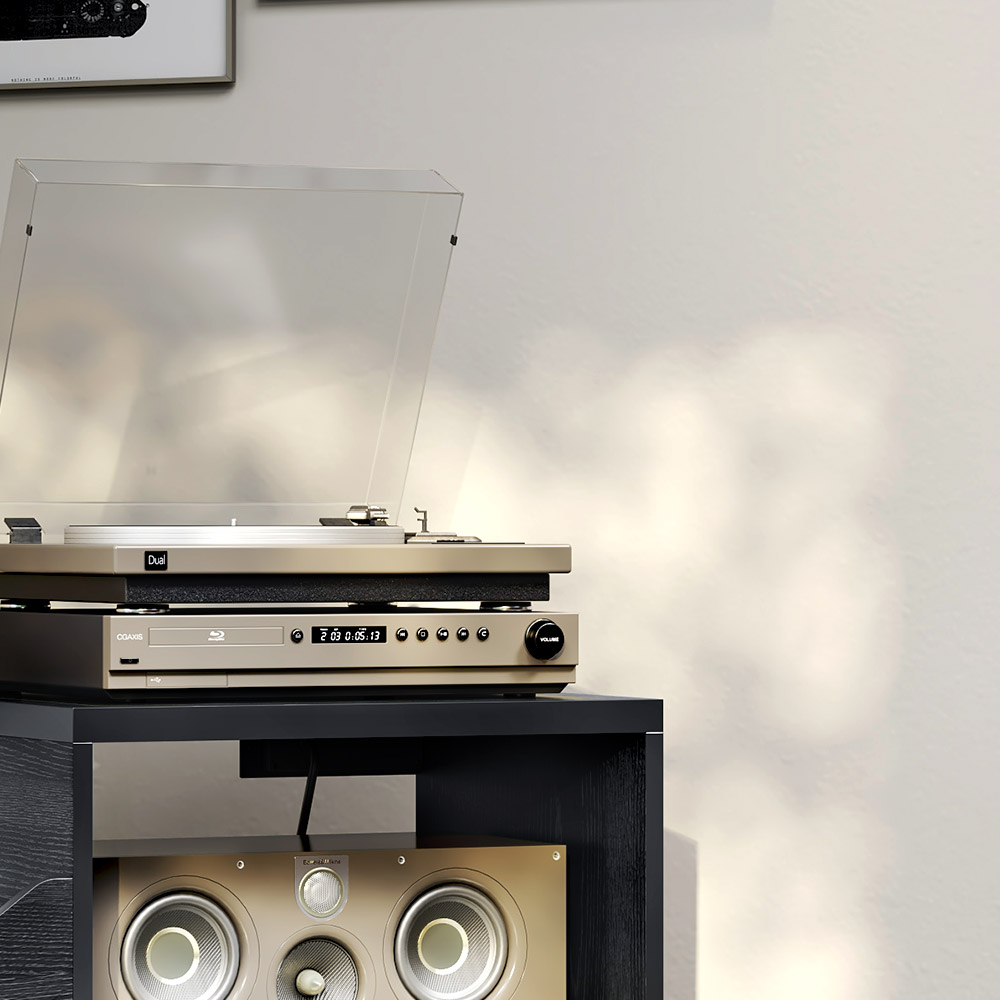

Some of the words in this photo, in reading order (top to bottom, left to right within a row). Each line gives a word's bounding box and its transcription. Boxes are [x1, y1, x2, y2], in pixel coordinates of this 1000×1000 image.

[148, 554, 166, 565] Dual
[320, 631, 327, 641] 2
[330, 631, 341, 641] 03
